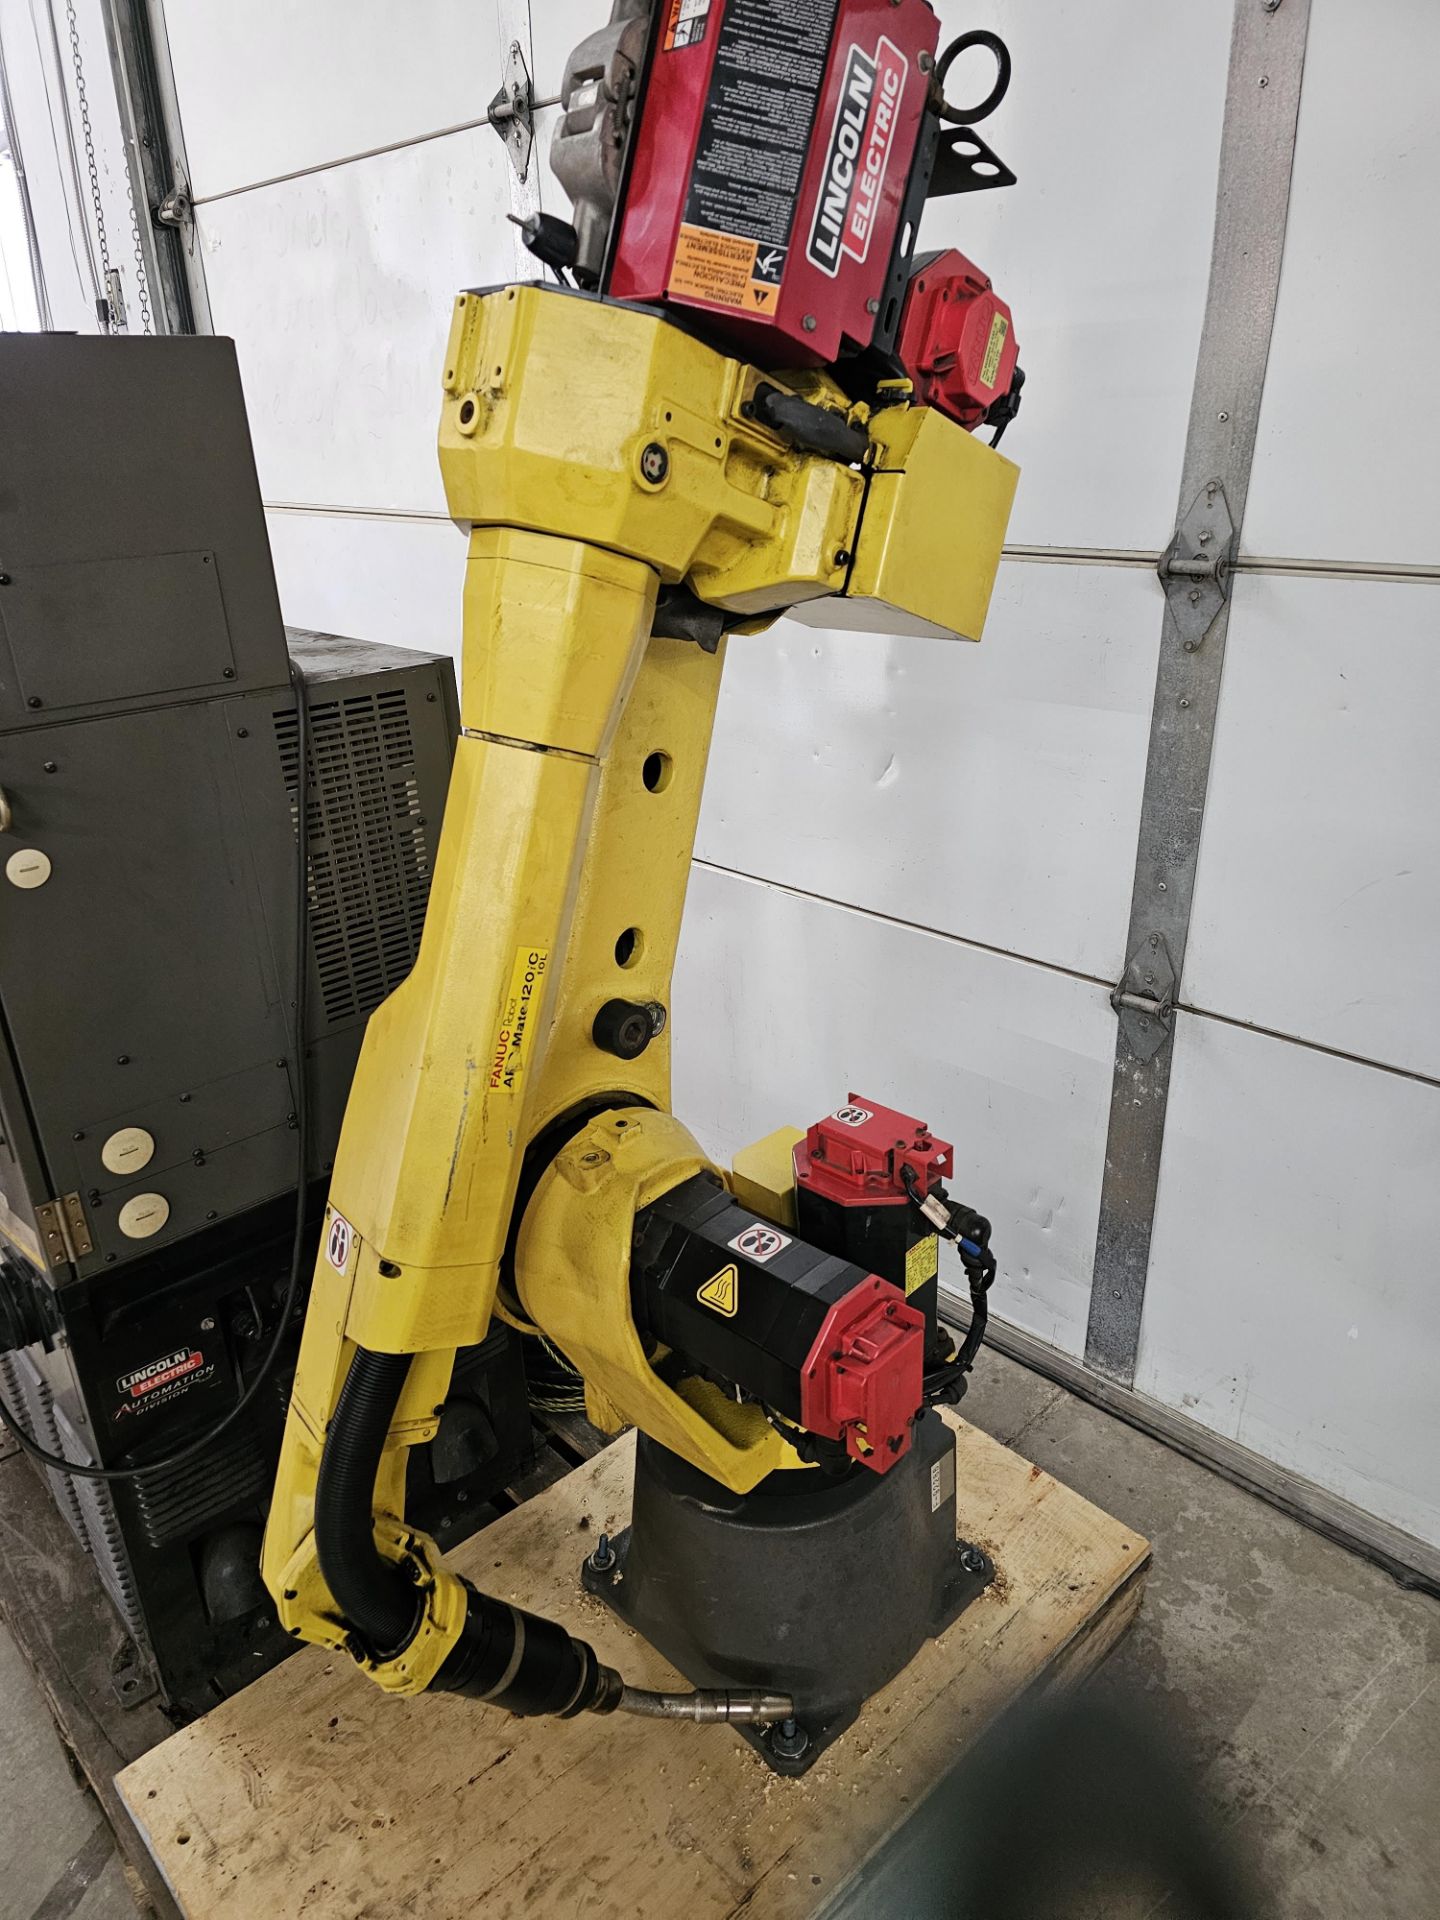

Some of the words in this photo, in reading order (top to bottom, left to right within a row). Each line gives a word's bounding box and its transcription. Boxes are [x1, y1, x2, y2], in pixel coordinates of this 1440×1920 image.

[815, 64, 874, 259] LINCOLN
[851, 68, 899, 240] ELECTRIC
[703, 291, 742, 305] WARNING
[537, 953, 547, 974] 10L
[512, 1004, 527, 1046] Mate
[489, 1029, 510, 1088] FANUC
[121, 1351, 186, 1389] LINCOLN
[140, 1359, 196, 1391] ELECTRIC
[115, 1364, 214, 1419] AUTOMATION
[136, 1387, 189, 1415] DIVISION
